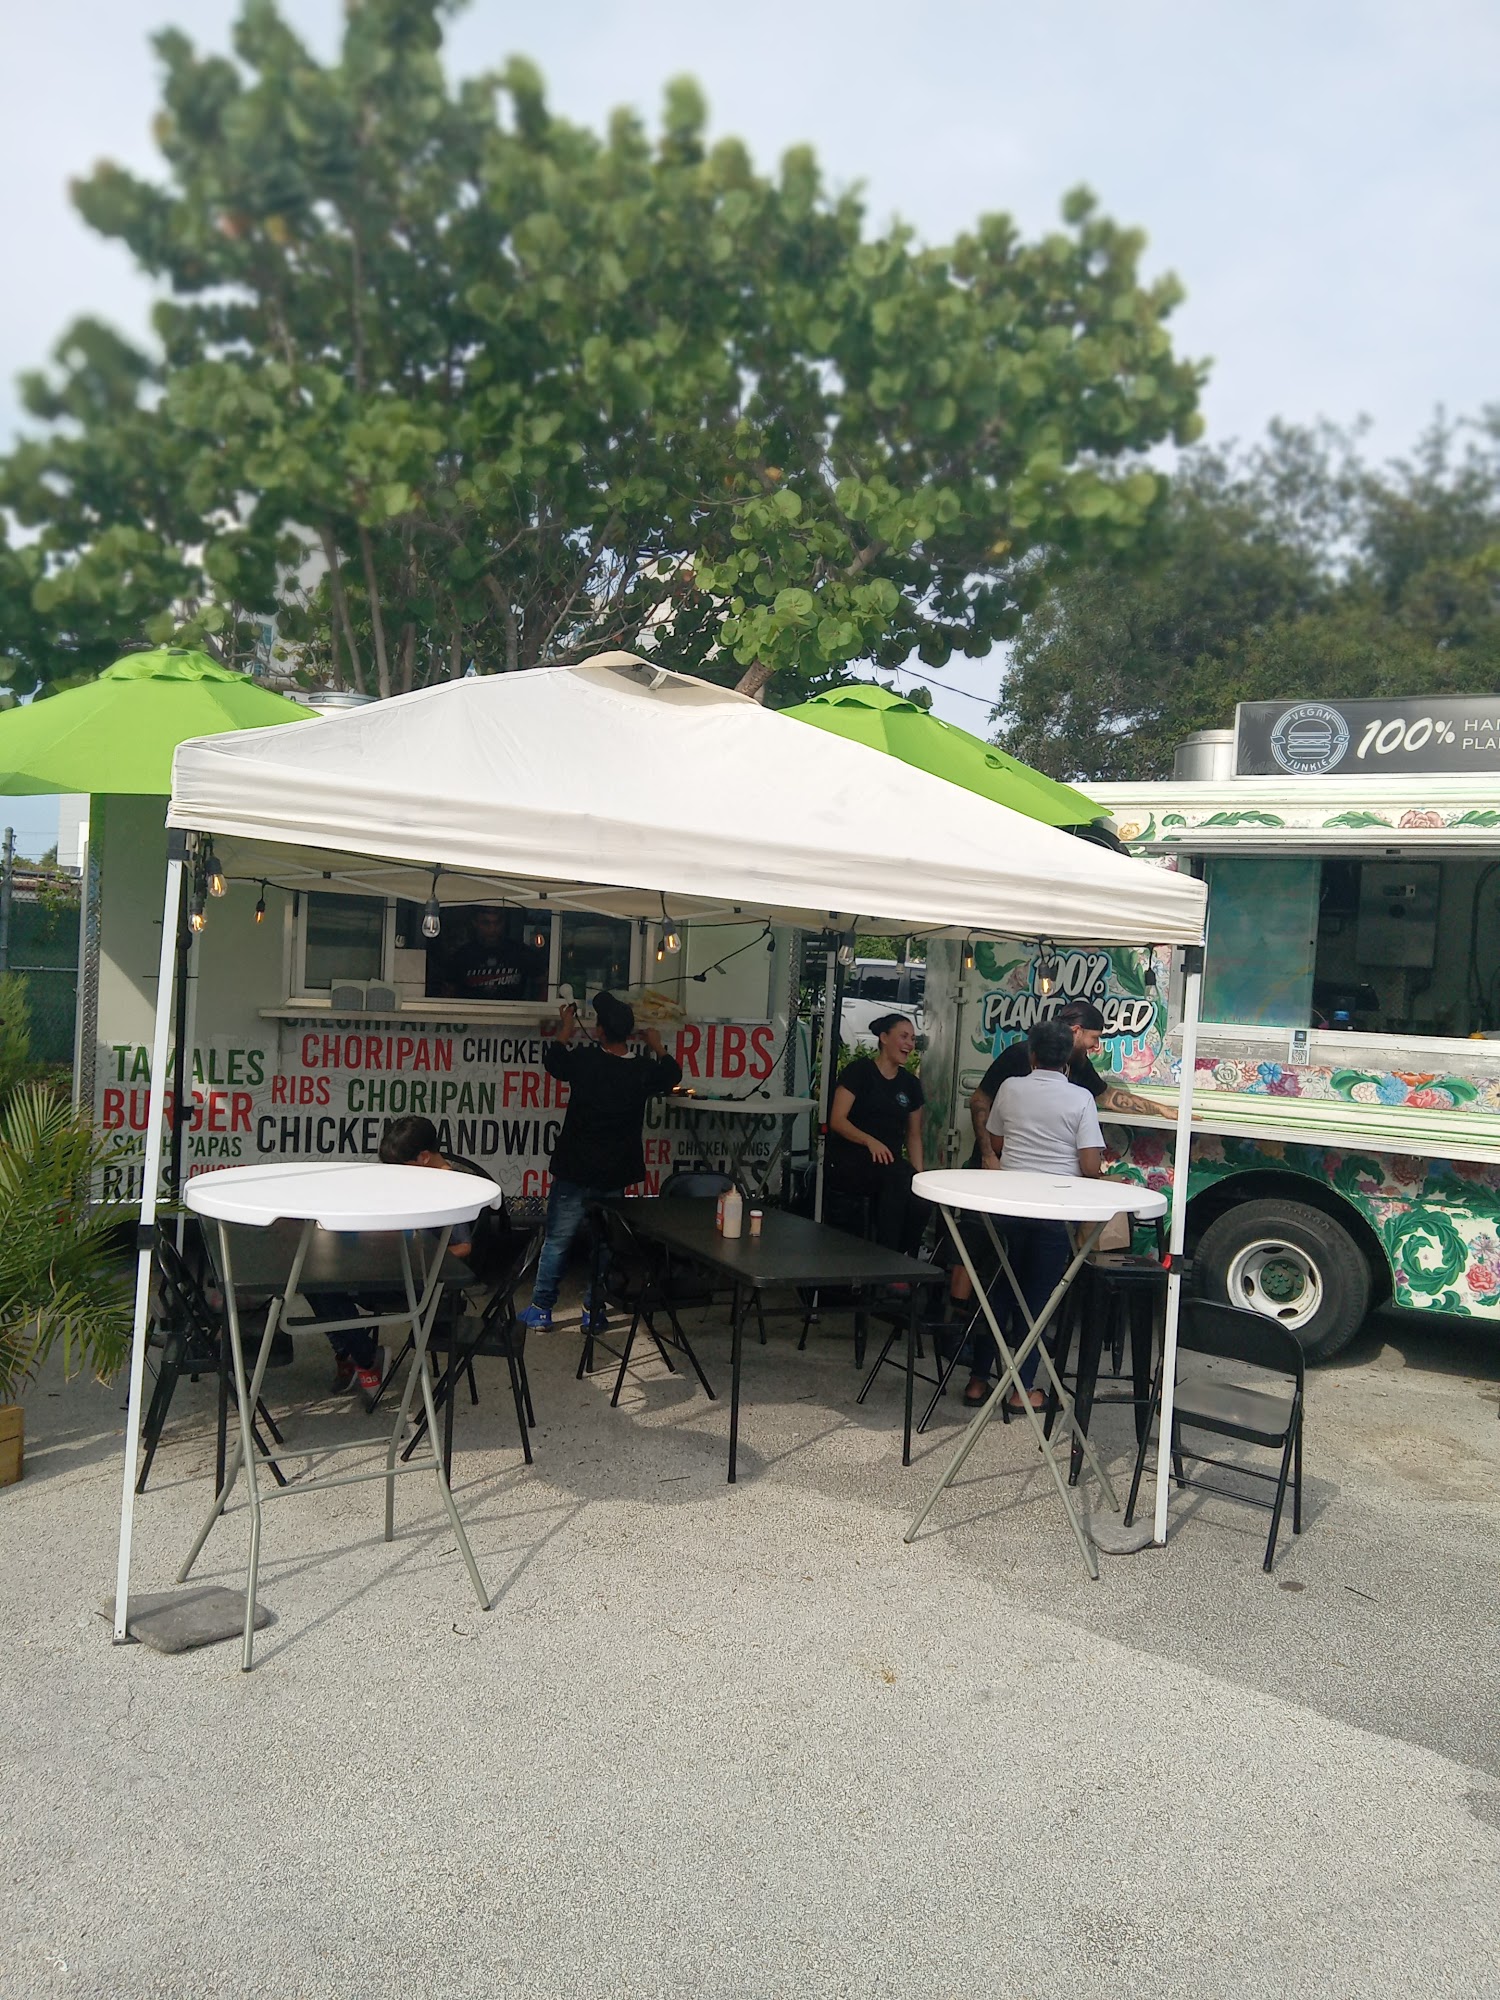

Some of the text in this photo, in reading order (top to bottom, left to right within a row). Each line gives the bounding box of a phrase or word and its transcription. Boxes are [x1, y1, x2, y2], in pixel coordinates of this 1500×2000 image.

[1292, 708, 1332, 721] VEGAN
[1357, 717, 1456, 759] 100%
[1287, 759, 1328, 772] JUNKIE
[301, 1033, 453, 1072] CHORIPAN
[676, 1024, 774, 1078] RIBS
[271, 1075, 331, 1106] RIBS
[347, 1078, 497, 1115] CHORIPAN
